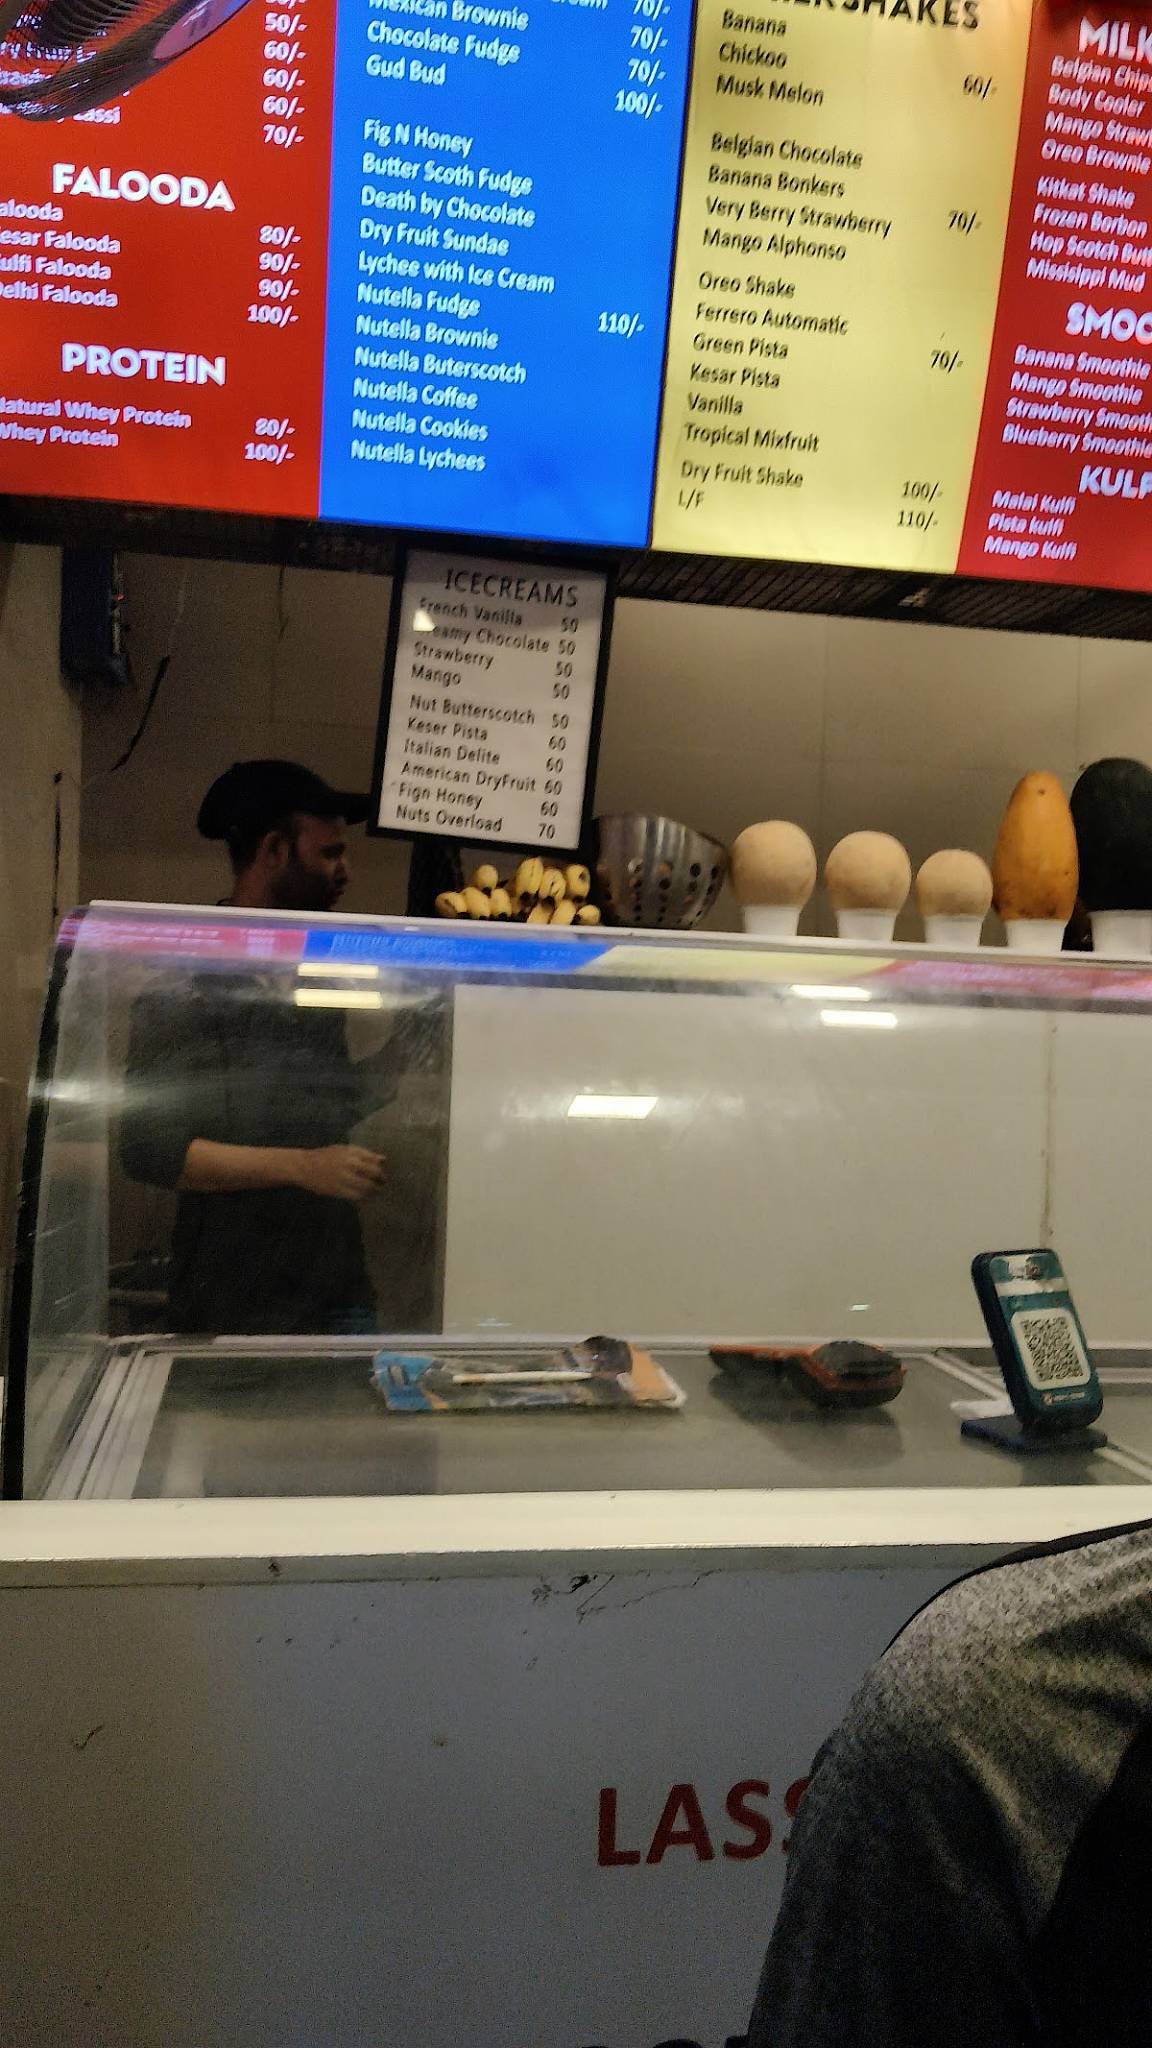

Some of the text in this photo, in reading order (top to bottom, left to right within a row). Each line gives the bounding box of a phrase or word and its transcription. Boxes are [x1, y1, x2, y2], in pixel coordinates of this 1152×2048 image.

[265, 13, 307, 37] 50/-
[452, 1, 529, 31] Brownie
[630, 25, 669, 54] 70/-
[722, 9, 787, 37] Banana
[263, 41, 306, 64] 60/-
[367, 20, 666, 87] Chocolate Fudge 70/-
[719, 42, 787, 69] Chickoo
[1051, 55, 1112, 85] Belgian
[263, 69, 305, 93] 60/-
[366, 54, 663, 120] Gud Bud 100/-
[716, 74, 824, 107] Musk Melon
[263, 96, 305, 119] 60/-
[1048, 82, 1146, 118] Body Cooler
[73, 106, 120, 124] assi
[263, 125, 305, 148] 70/-
[363, 118, 473, 159] Fig N Honey
[1045, 110, 1104, 141] Mango
[711, 132, 863, 170] Belgian Chocolate
[1042, 138, 1151, 175] Oreo Brownie
[53, 163, 236, 212] FALOODA
[362, 152, 421, 180] Butter
[478, 168, 533, 199] Fudge
[708, 165, 846, 198] Banana Bonkers
[361, 185, 536, 228] Death by Chocolate
[1087, 182, 1136, 209] Shake
[706, 195, 892, 239] Very Berry Strawberry
[949, 209, 981, 236] 70/-
[1033, 202, 1148, 239] Frozen Borbon
[0, 229, 300, 274] esar Falooda 90/-
[259, 225, 301, 248] 80/-
[360, 217, 510, 257] Dry Fruit Sundae
[703, 227, 847, 261] Mango Alphonso
[1030, 230, 1065, 257] Hop
[1066, 235, 1120, 262] Scotch
[0, 254, 300, 301] ulfi Falooda 90/-
[358, 250, 555, 294] Lychee with Ice Cream
[699, 271, 796, 299] Oreo Shake
[1108, 268, 1146, 293] Mud
[42, 284, 118, 307] Falooda
[247, 304, 299, 328] 100/-
[357, 282, 481, 319] Nutella Fudge
[355, 314, 499, 351] Nutella Brownie
[598, 311, 645, 339] 110/-
[696, 302, 849, 336] Ferrero Automatic
[354, 346, 420, 373] Nutella
[693, 332, 789, 359] Green Pista
[930, 349, 964, 374] 70/-
[1014, 344, 1151, 381] Banana Smoothie
[61, 342, 226, 386] PROTEIN
[690, 363, 781, 389] Kesar Pista
[353, 376, 479, 410] Nutella Coffee
[688, 392, 744, 415] Vanilla
[1011, 371, 1143, 407] Mango Smoothie
[64, 401, 120, 425] Whey
[123, 405, 192, 428] Protein
[255, 418, 296, 439] 80/-
[352, 408, 488, 442] Nutella Cookies
[1006, 397, 1094, 428] Strawberry
[50, 426, 119, 447] Protein
[244, 442, 295, 464] 100/-
[684, 422, 749, 447] Tropical
[1002, 423, 1152, 459] Blueberry Smoothie
[351, 439, 487, 472] Nutella Lychees
[681, 460, 943, 503] Dry Fruit Shake 100/-
[678, 488, 939, 531] L/F 110/-
[992, 489, 1039, 512] Malai
[988, 513, 1028, 534] Pista
[984, 535, 1039, 560] Mango
[444, 567, 579, 608] ICECREAMS
[419, 597, 579, 633] French Vanilla 50
[476, 627, 549, 653] Chocolate
[559, 639, 577, 656] 50
[413, 640, 573, 679] Strawberry 50
[411, 663, 570, 700] Mango 50
[409, 694, 570, 730] Nut Butterscotch 50
[452, 721, 488, 742] Pista
[548, 735, 567, 752] 60
[404, 738, 564, 774] Italian Delite 60
[401, 761, 563, 796] American DryFruit 60
[436, 787, 484, 810] Honey
[540, 801, 559, 817] 60
[396, 804, 556, 840] Nuts Overload 70
